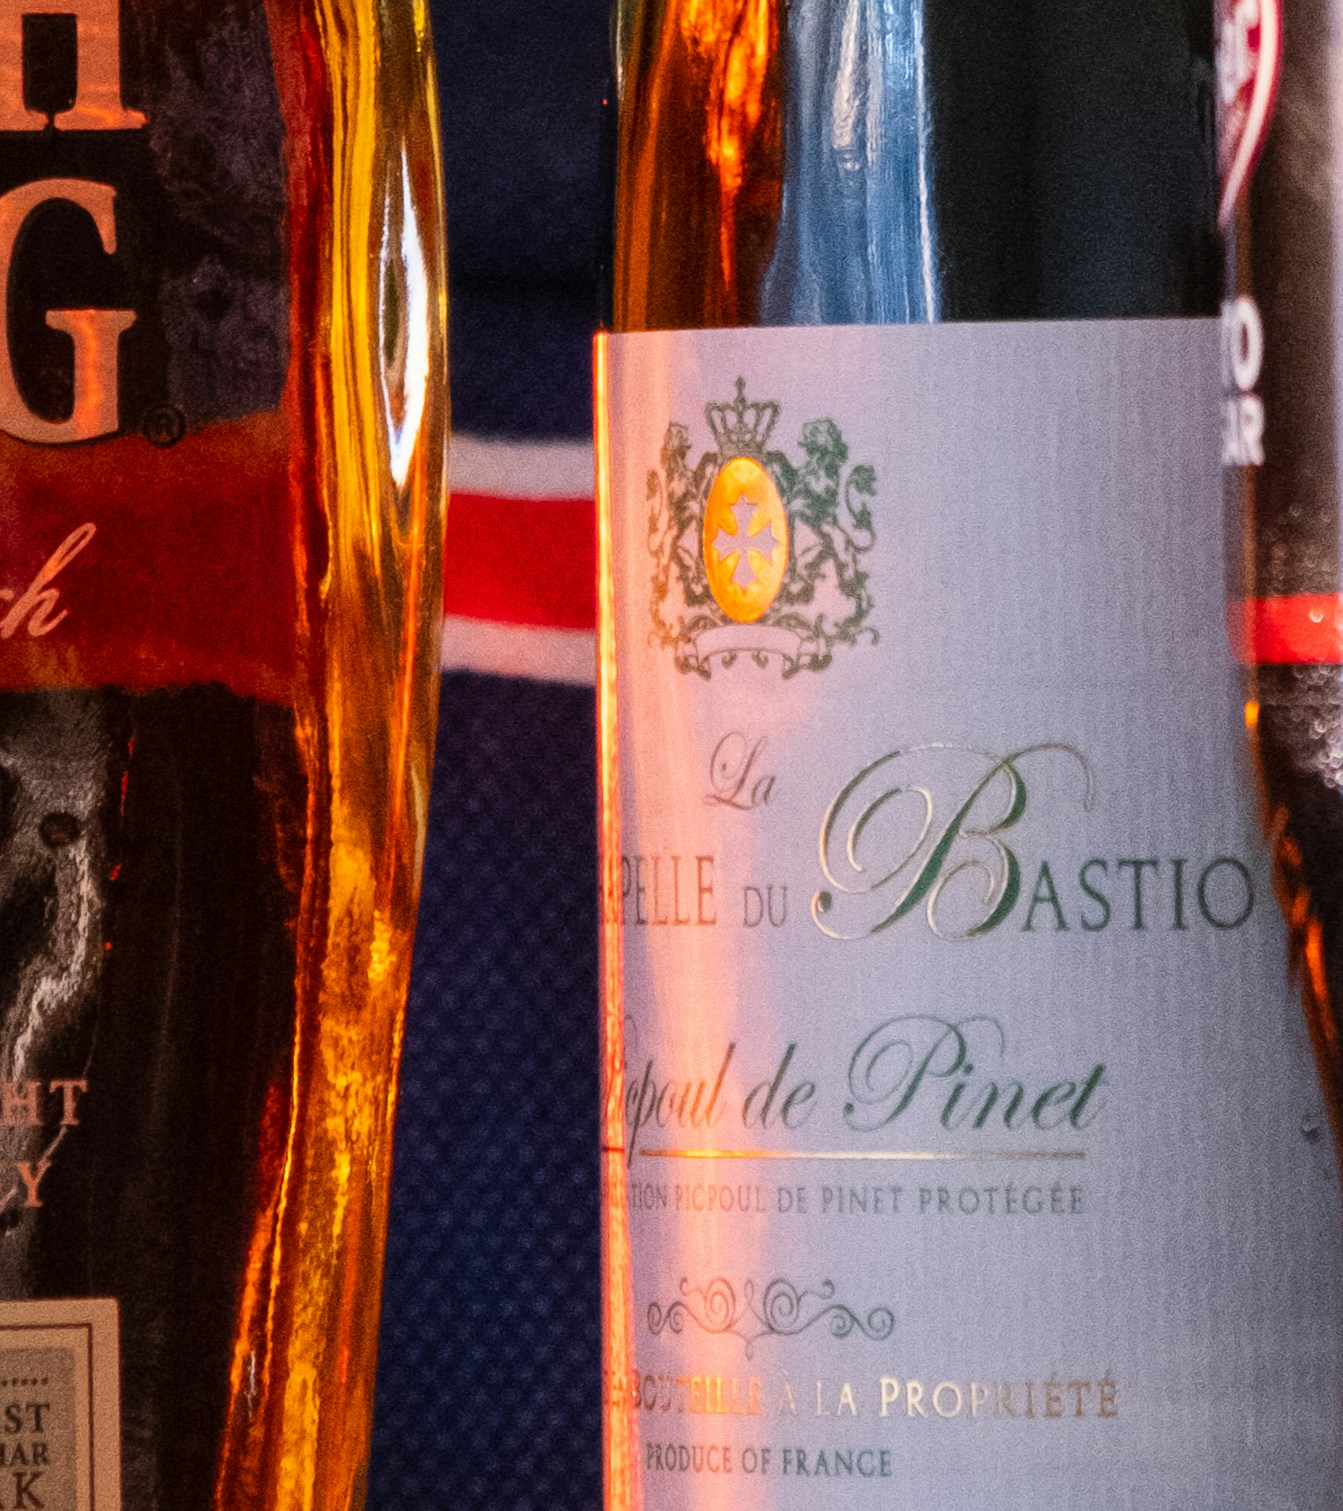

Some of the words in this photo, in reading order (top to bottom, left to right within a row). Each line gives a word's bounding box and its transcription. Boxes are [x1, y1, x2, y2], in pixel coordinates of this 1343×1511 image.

[706, 730, 776, 812] La
[742, 884, 788, 928] DU
[741, 1041, 817, 1130] de
[842, 1012, 1108, 1134] Pinet
[674, 1184, 768, 1213] PICPOUL
[776, 1186, 809, 1214] DE
[821, 1185, 904, 1215] PINET
[917, 1179, 1086, 1216] PROTÉGÉE
[815, 1378, 859, 1417] LA
[878, 1370, 1120, 1419] PROPRIÉTÉ
[644, 1443, 733, 1475] PRODUCE
[740, 1445, 773, 1475] OF
[782, 1446, 893, 1478] FRANCE
